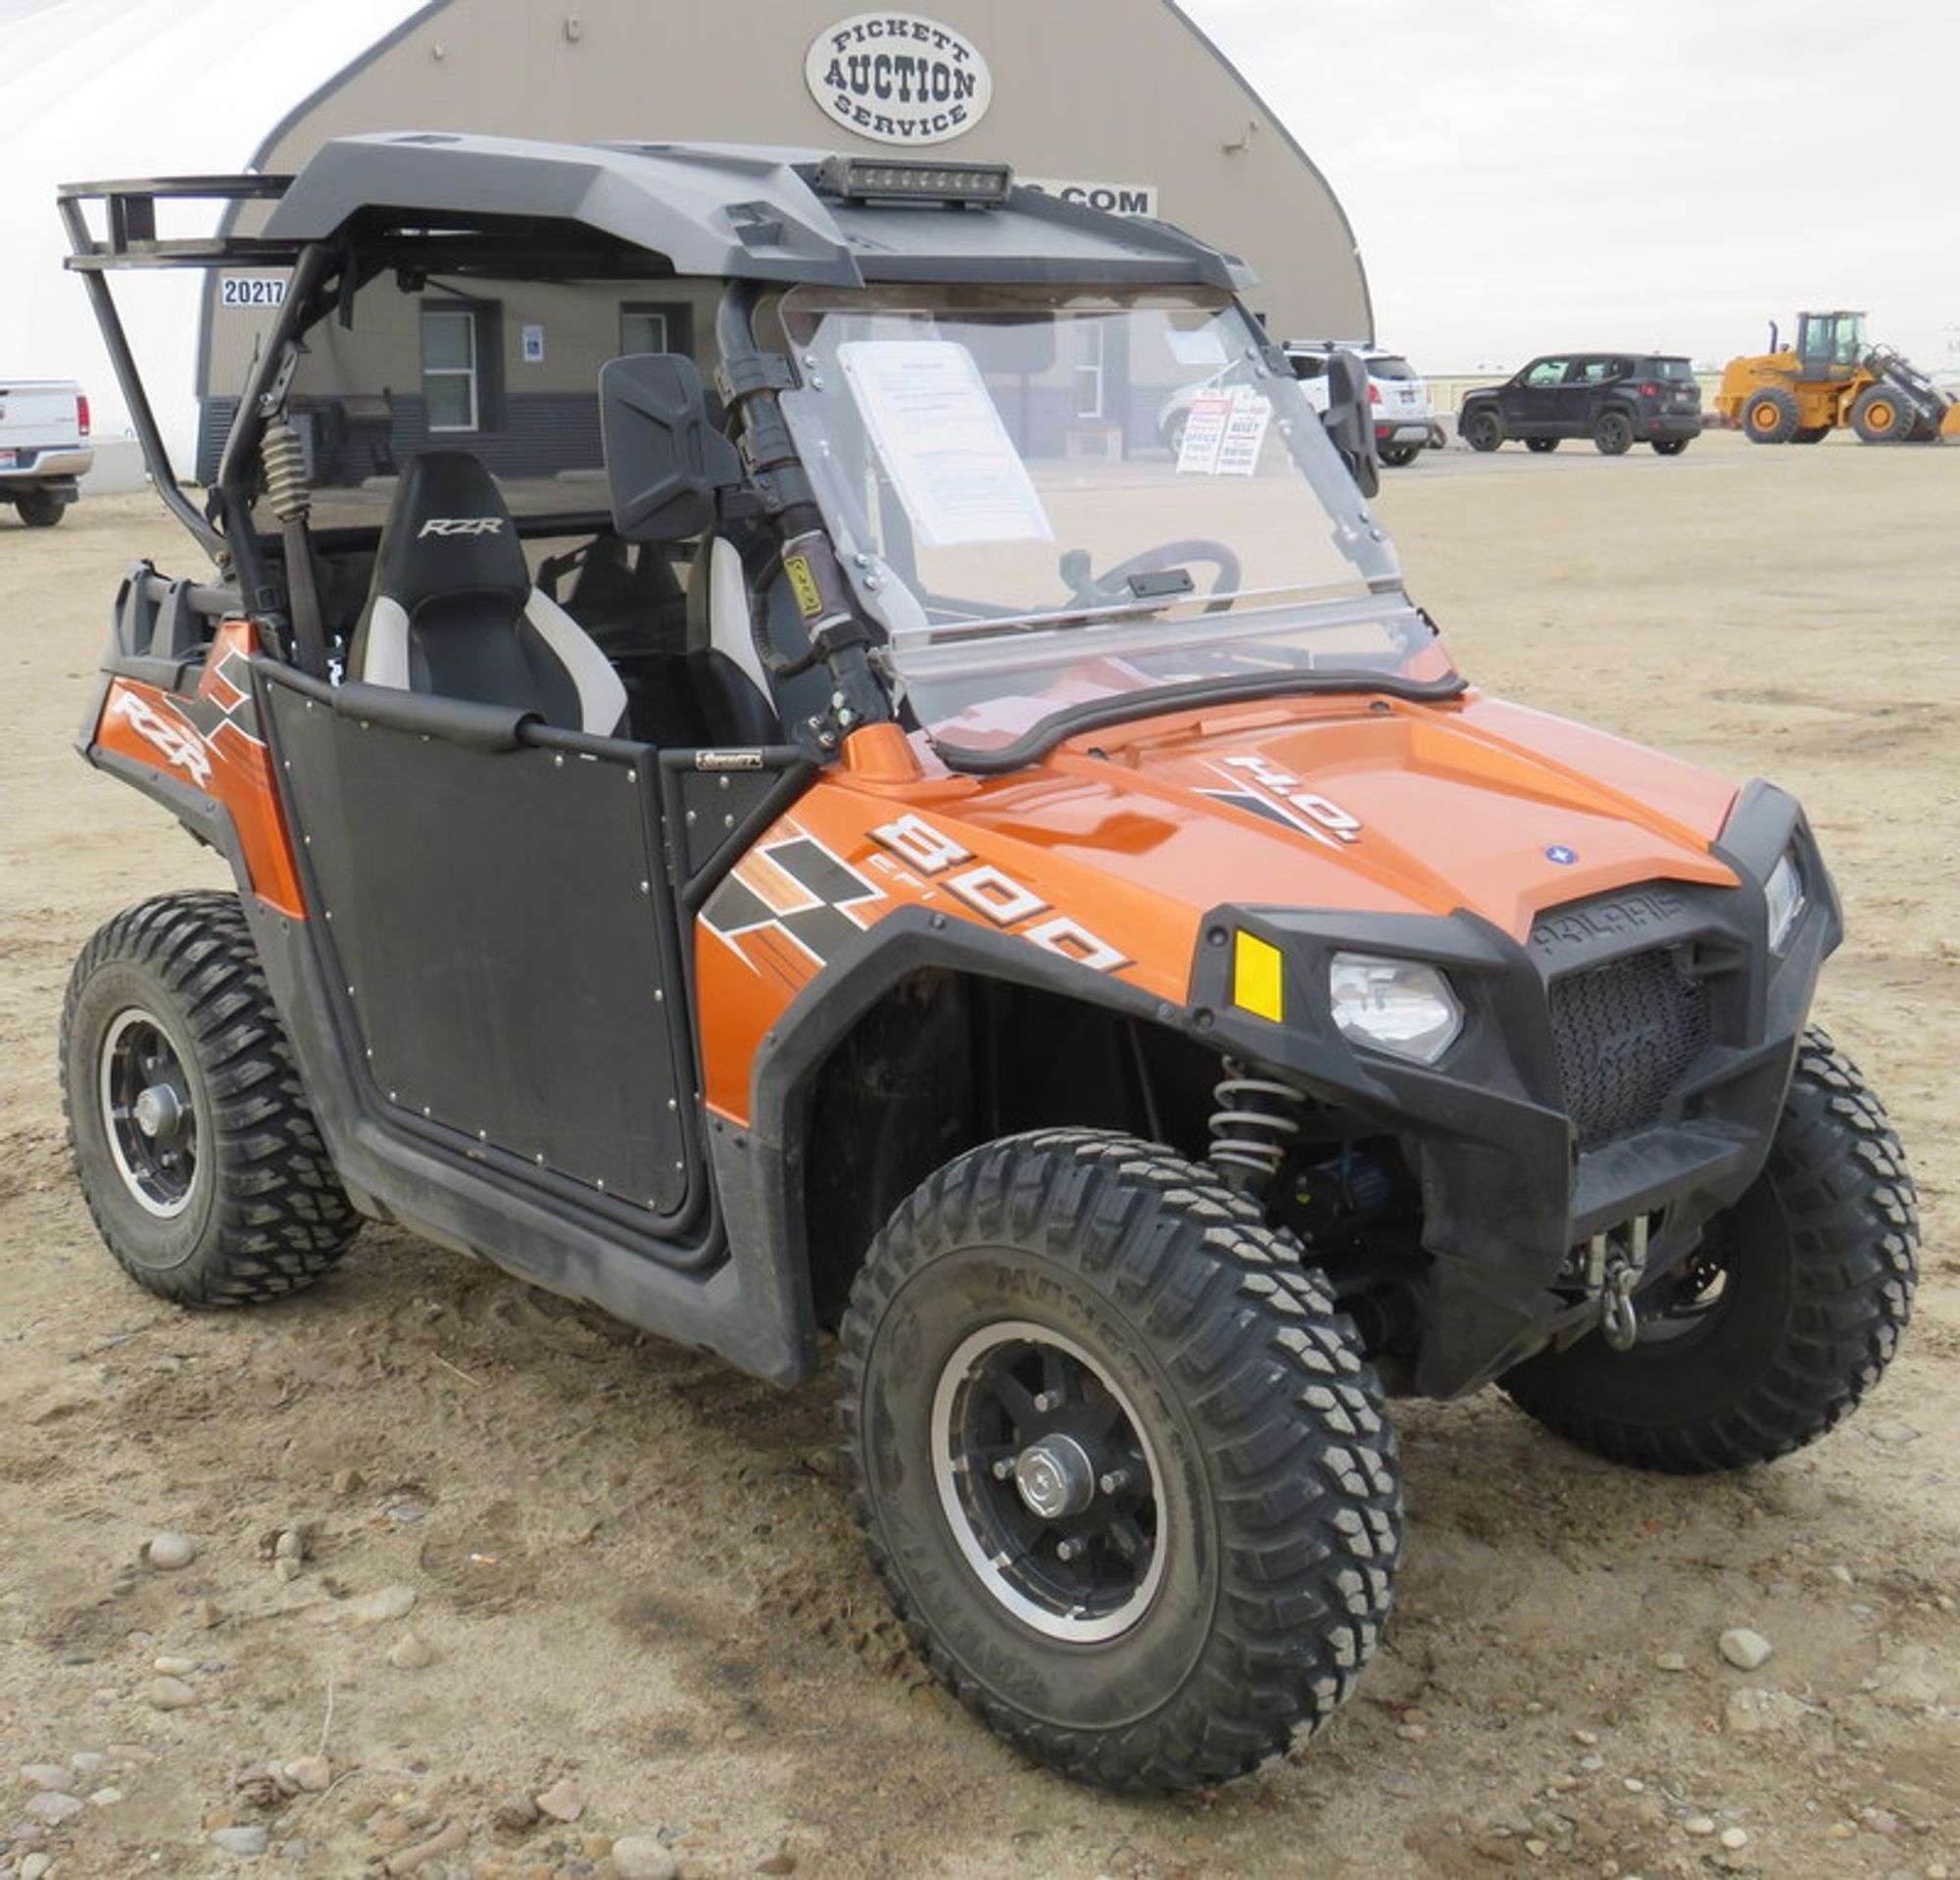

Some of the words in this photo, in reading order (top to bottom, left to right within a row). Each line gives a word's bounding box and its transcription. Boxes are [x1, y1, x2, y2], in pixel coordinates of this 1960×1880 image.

[832, 20, 970, 63] PICKETT
[824, 54, 976, 103] AUCTION
[834, 94, 967, 136] SERVICE
[224, 279, 283, 303] 20217
[417, 518, 504, 538] RZR
[113, 690, 211, 787] RZR
[864, 813, 1137, 972] 800
[1533, 892, 1685, 956] POLARIS
